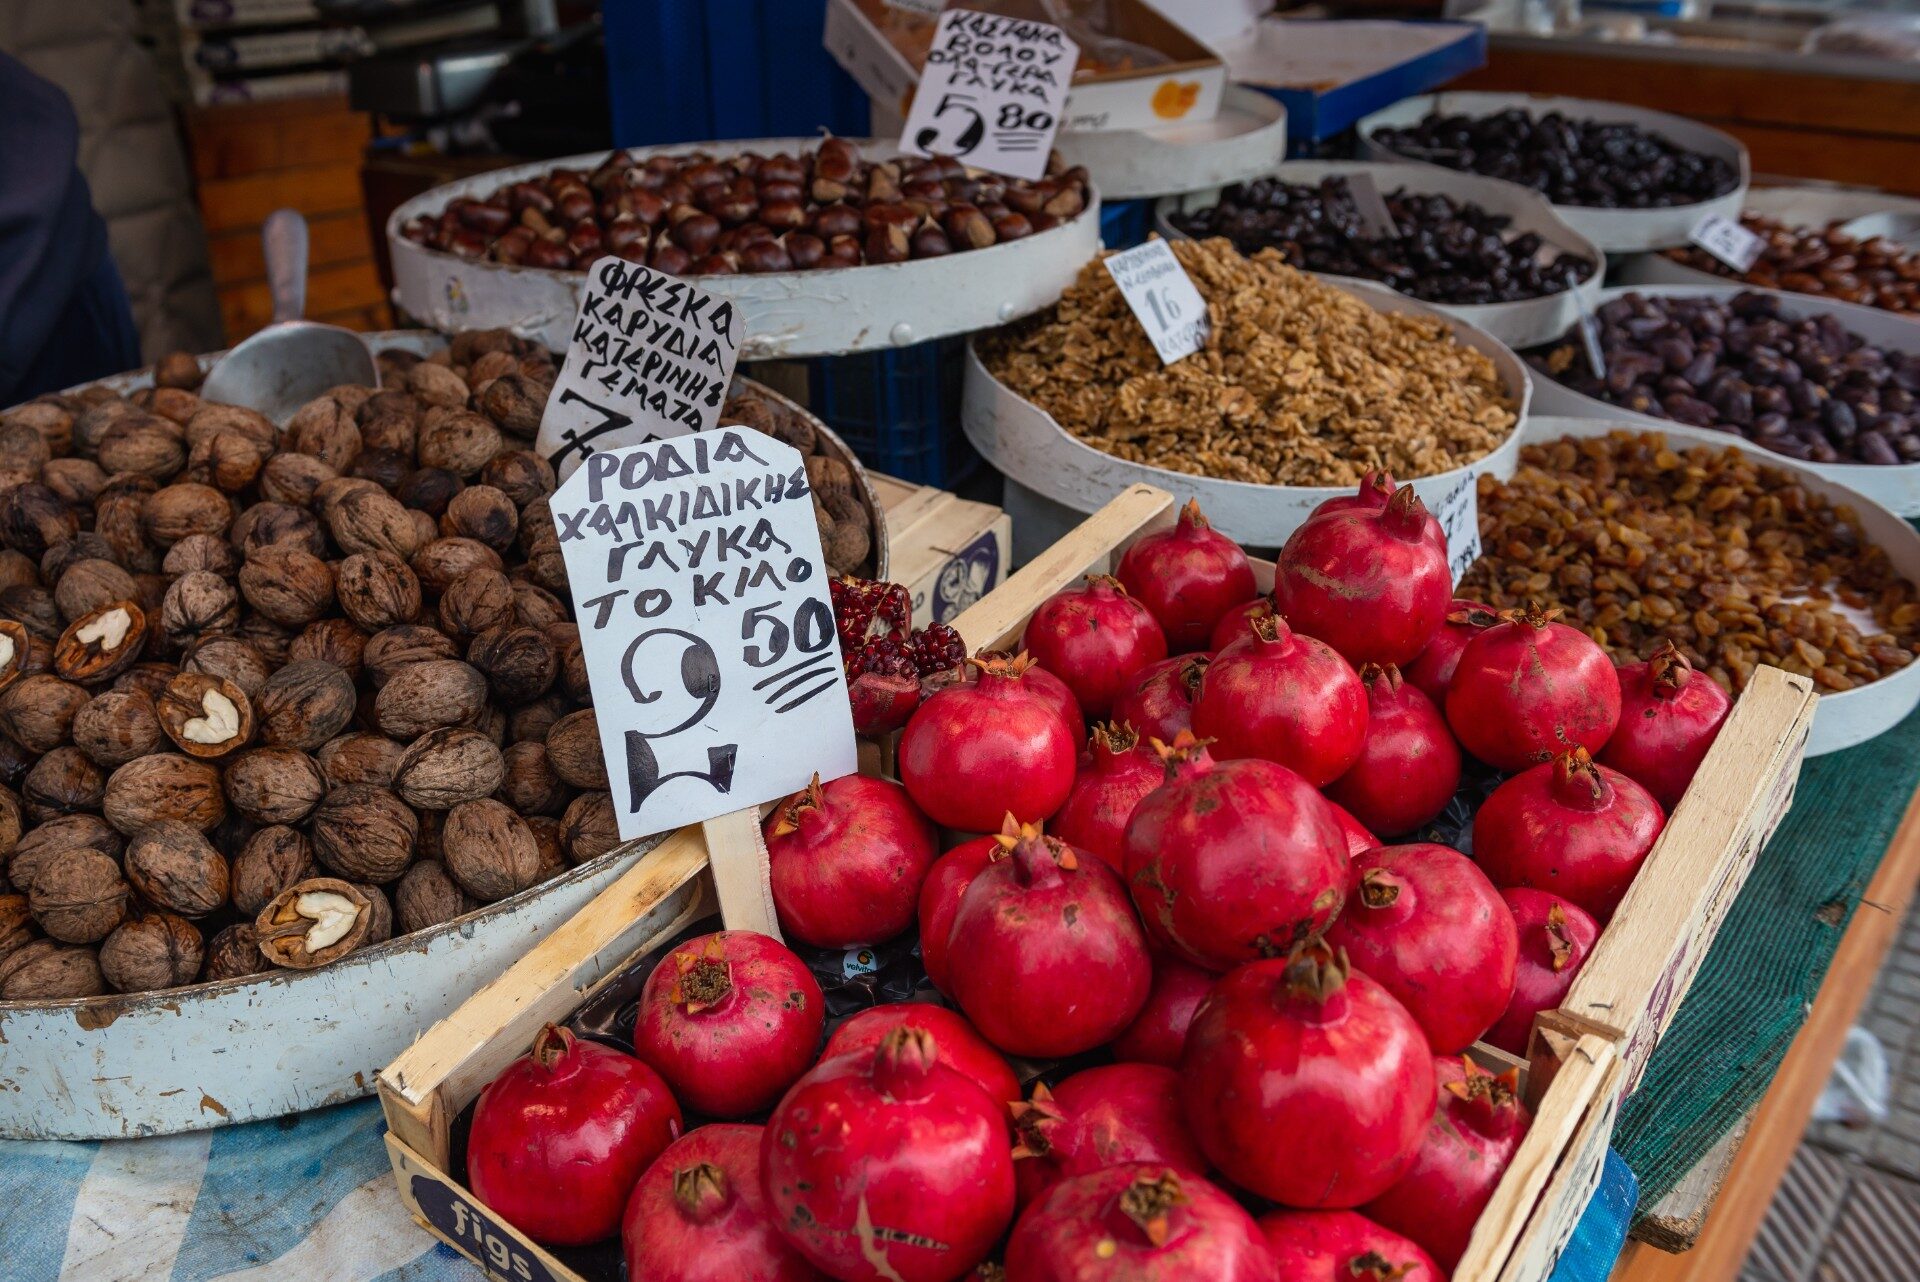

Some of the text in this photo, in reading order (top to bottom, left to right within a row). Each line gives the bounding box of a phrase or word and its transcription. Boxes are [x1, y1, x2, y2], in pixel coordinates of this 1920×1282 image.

[946, 33, 1062, 65] ΒΟΛΟΥ
[915, 93, 1054, 157] 5 80
[948, 71, 1050, 105] ΓΛΥΚΑ
[583, 291, 725, 377] ΚΑΡΥΔΙΑ
[600, 260, 735, 350] ΦΡΕΣΚΑ
[572, 319, 725, 408] ΚΑΤΕΡΙΝΗΣ
[580, 358, 703, 433] ΓΕΜΑΤΑ
[557, 466, 812, 543] ΧΑΛΚΙΔΙΚΗΣ
[587, 431, 770, 503] ΡΟΔΙΑ
[606, 517, 793, 583] ΓΛΥΚΑ
[581, 556, 813, 630] ΤΟ ΚΙΛΟ
[620, 596, 835, 814] 2 50
[450, 1200, 533, 1281] figs
